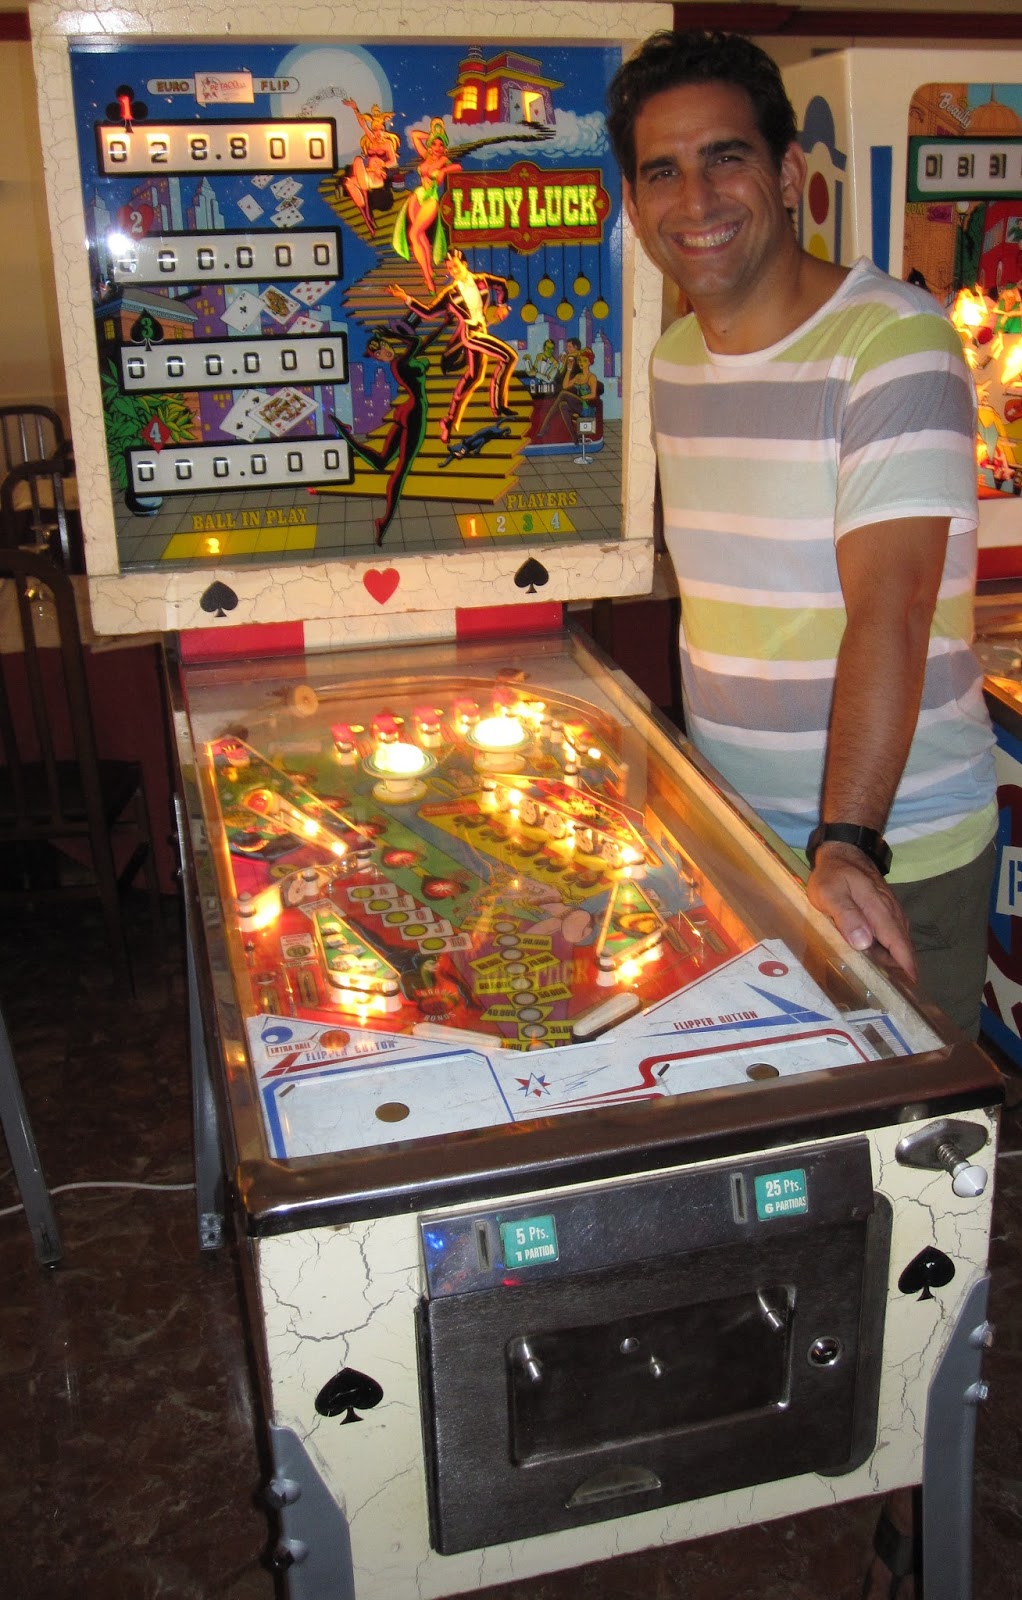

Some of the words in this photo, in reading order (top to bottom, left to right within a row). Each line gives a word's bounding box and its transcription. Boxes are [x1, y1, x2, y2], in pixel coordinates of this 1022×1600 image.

[156, 81, 190, 93] EURO
[260, 80, 290, 92] FLIP
[938, 92, 972, 130] Beauty
[452, 187, 523, 230] LADY
[528, 184, 598, 228] LUCK
[130, 212, 143, 233] 2
[140, 318, 154, 338] 3
[150, 423, 161, 443] 4
[506, 491, 578, 509] PLAYERS
[192, 512, 236, 530] BALL
[241, 510, 261, 527] IN
[266, 508, 308, 525] PLAY
[469, 517, 478, 537] 1
[496, 516, 506, 533] 2
[523, 514, 534, 532] 3
[551, 512, 560, 530] 4
[424, 1011, 457, 1022] BONUS
[487, 1008, 517, 1017] 40.000
[673, 1017, 714, 1031] FLIPPER
[718, 1010, 758, 1024] BUTTON
[270, 1045, 293, 1055] EXTRA
[295, 1042, 311, 1052] BALL
[765, 1179, 782, 1198] 25
[783, 1179, 802, 1194] Pts.
[764, 1203, 774, 1214] 6
[775, 1196, 807, 1212] PARTIDAS
[515, 1228, 526, 1246] 5
[528, 1226, 549, 1241] Pts.
[515, 1251, 523, 1262] 1
[524, 1244, 555, 1260] PARTIDA
